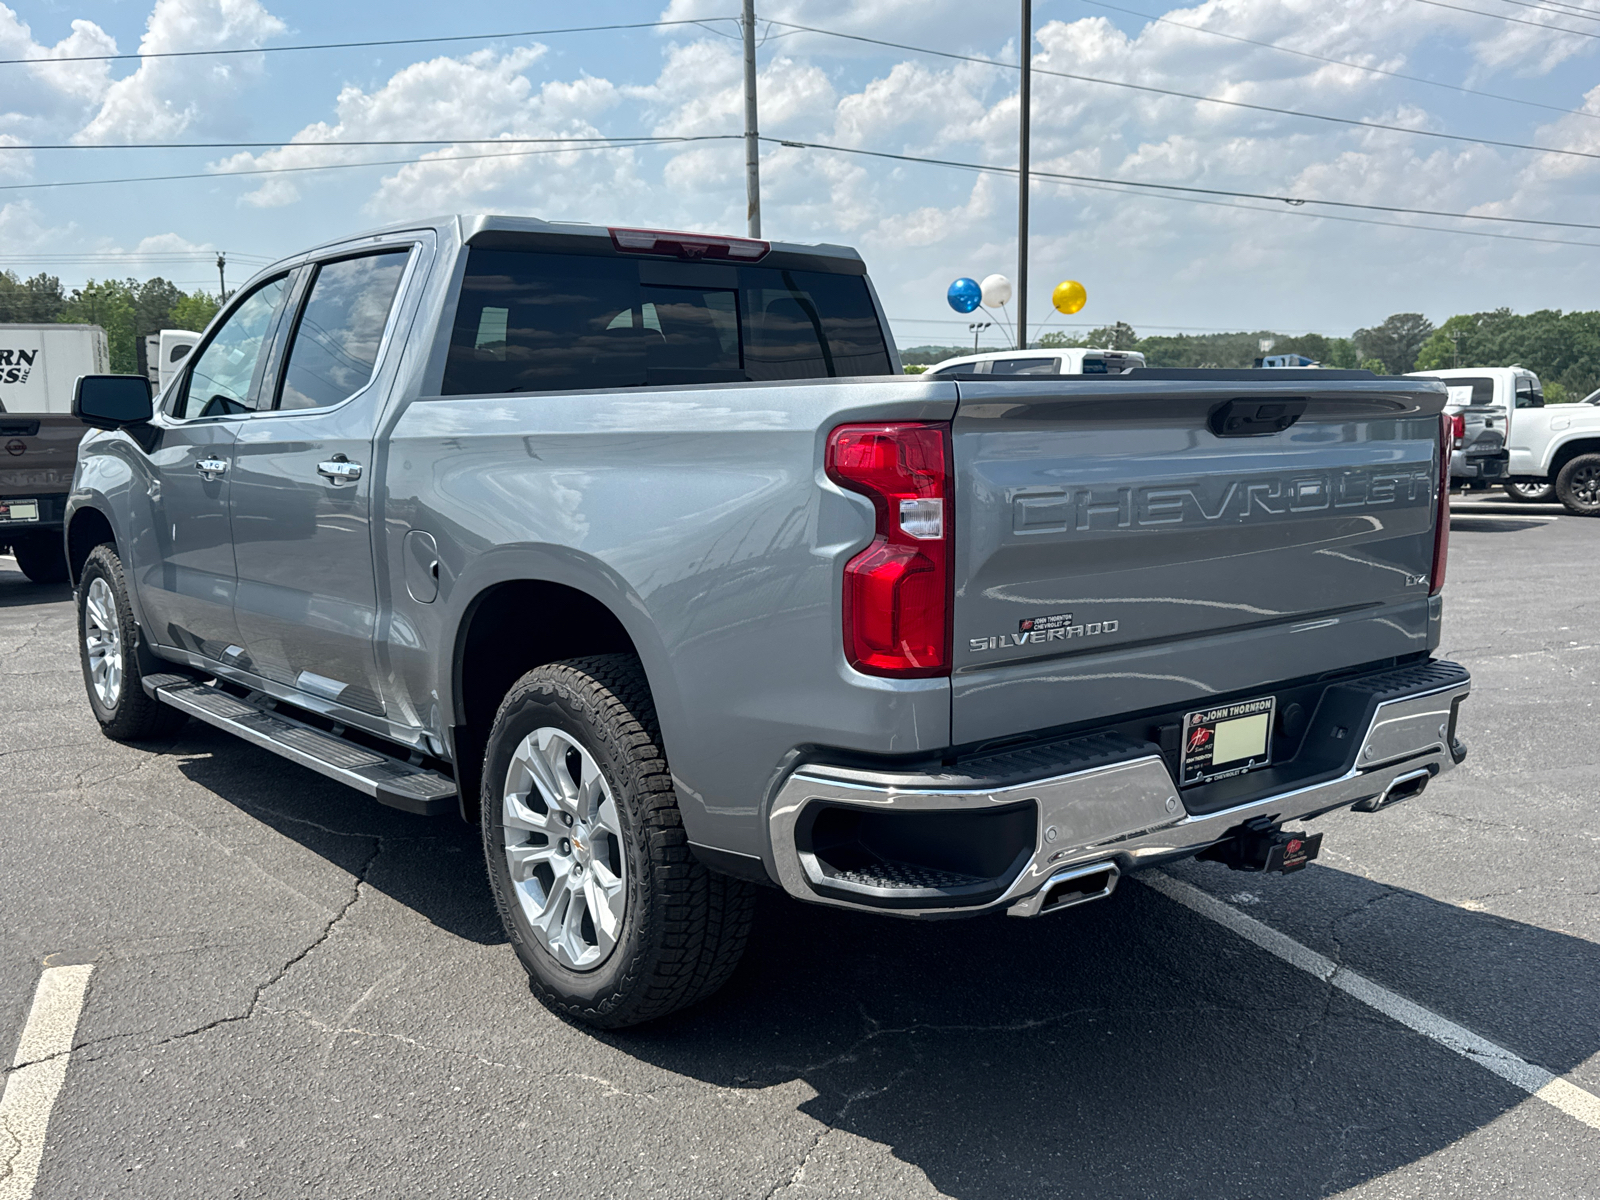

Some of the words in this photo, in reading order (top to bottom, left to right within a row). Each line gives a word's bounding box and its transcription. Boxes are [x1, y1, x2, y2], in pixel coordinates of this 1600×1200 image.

[0, 367, 21, 384] S
[1012, 471, 1429, 536] CHEVROLET
[1033, 617, 1047, 625] JOHN
[1047, 613, 1072, 623] THORNTON
[1033, 621, 1063, 631] CHEVROLET
[969, 620, 1119, 652] SILVERADO
[1206, 710, 1228, 721] JOHN
[1229, 699, 1272, 716] THORNTON
[1214, 770, 1240, 781] CHEVROLET
